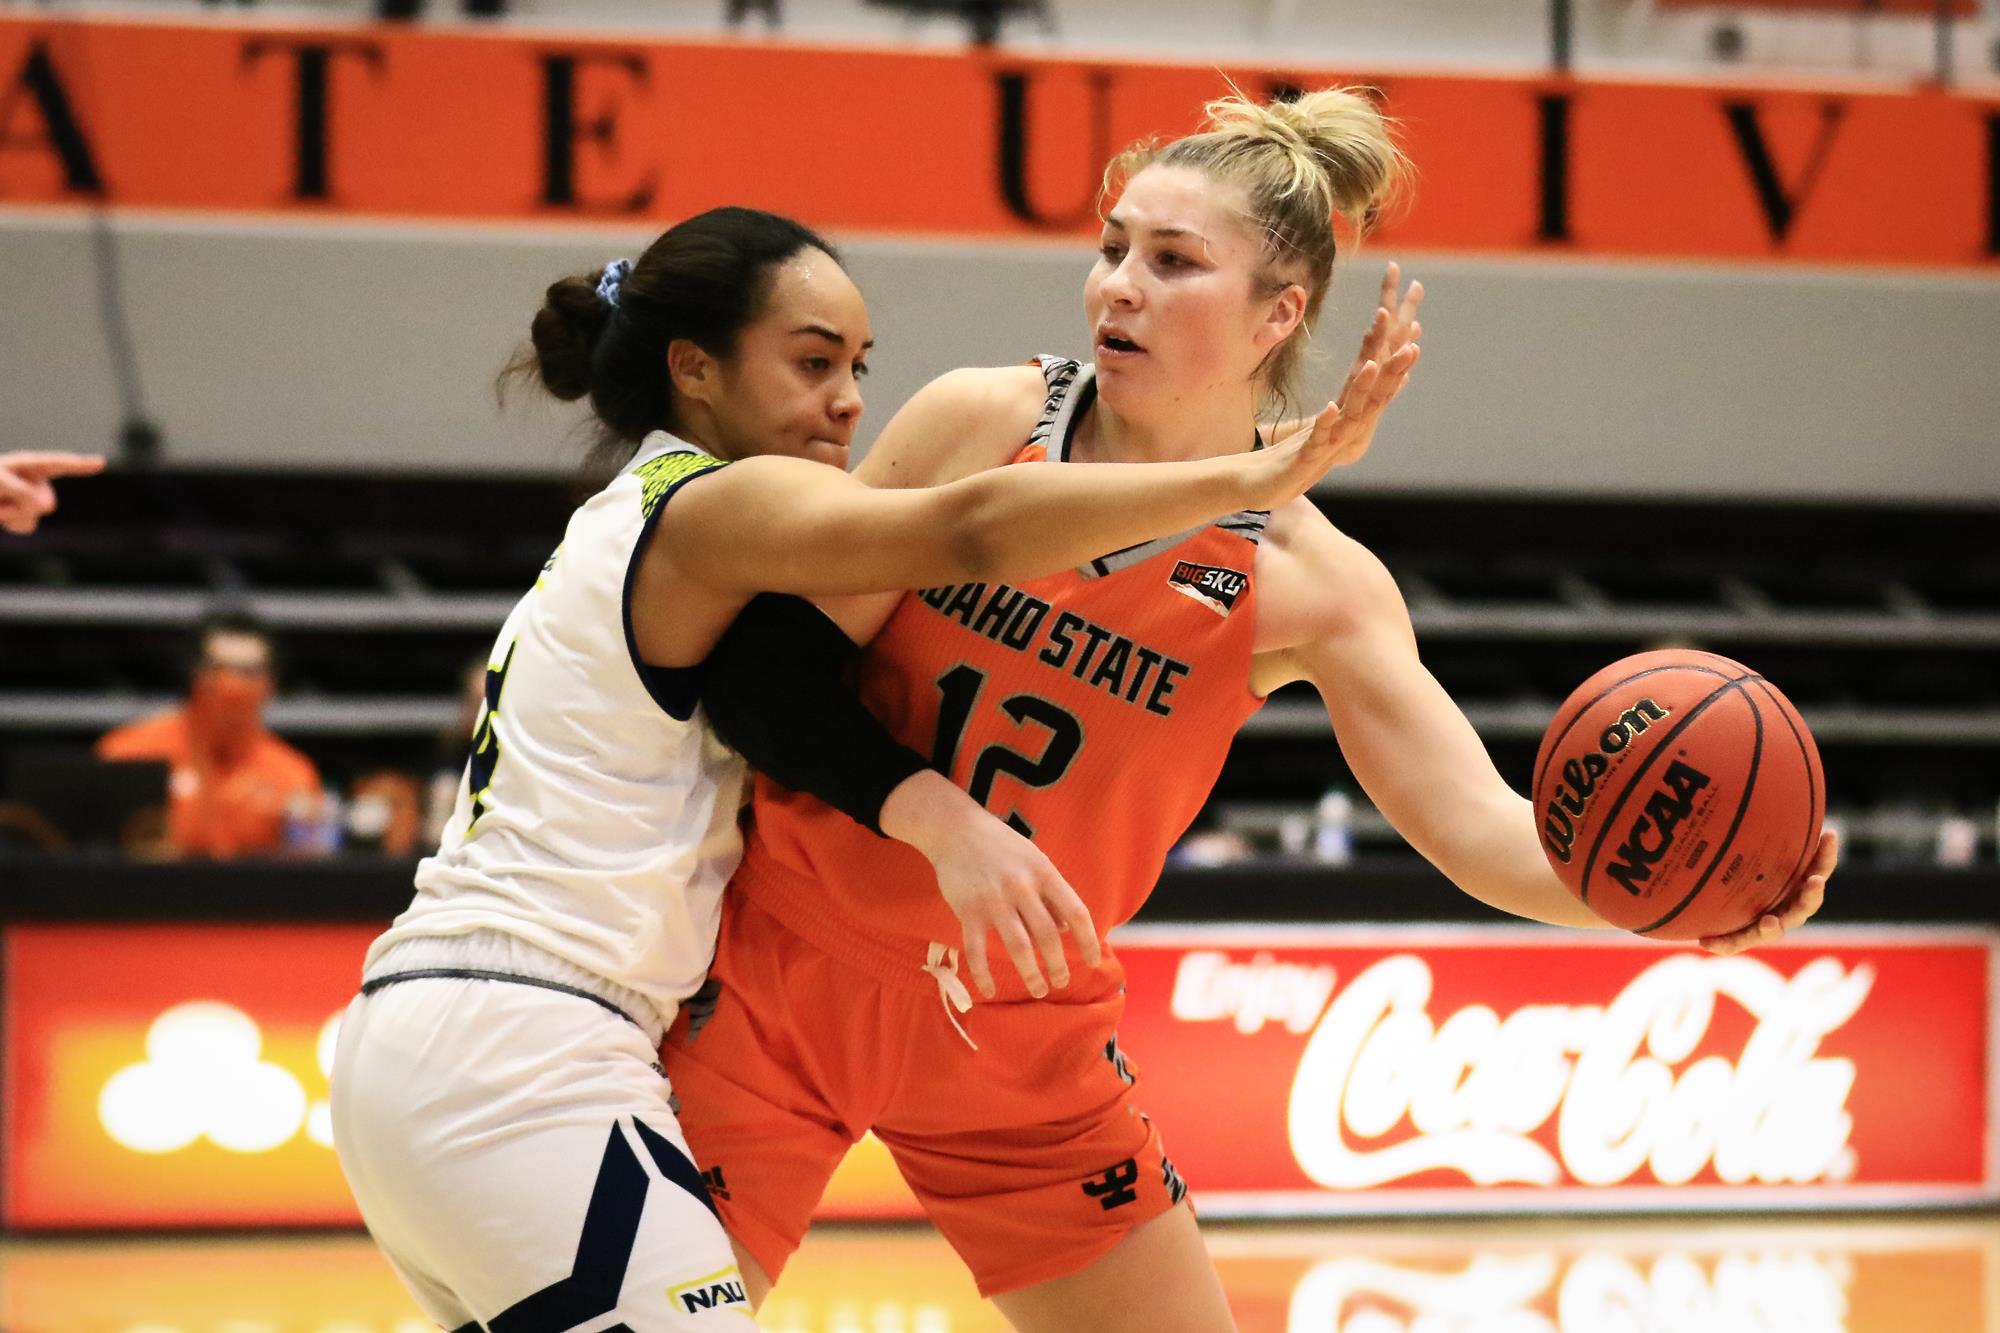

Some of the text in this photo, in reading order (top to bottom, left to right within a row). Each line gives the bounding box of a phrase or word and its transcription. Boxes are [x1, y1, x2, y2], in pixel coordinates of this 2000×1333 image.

[987, 66, 2000, 262] UIV
[917, 582, 1192, 717] AHO STATE
[932, 660, 1085, 840] 12
[1544, 697, 1671, 865] Wilson
[1605, 758, 1711, 897] NCAA
[1171, 950, 1338, 1034] Enjoy
[680, 1281, 747, 1314] NAU
